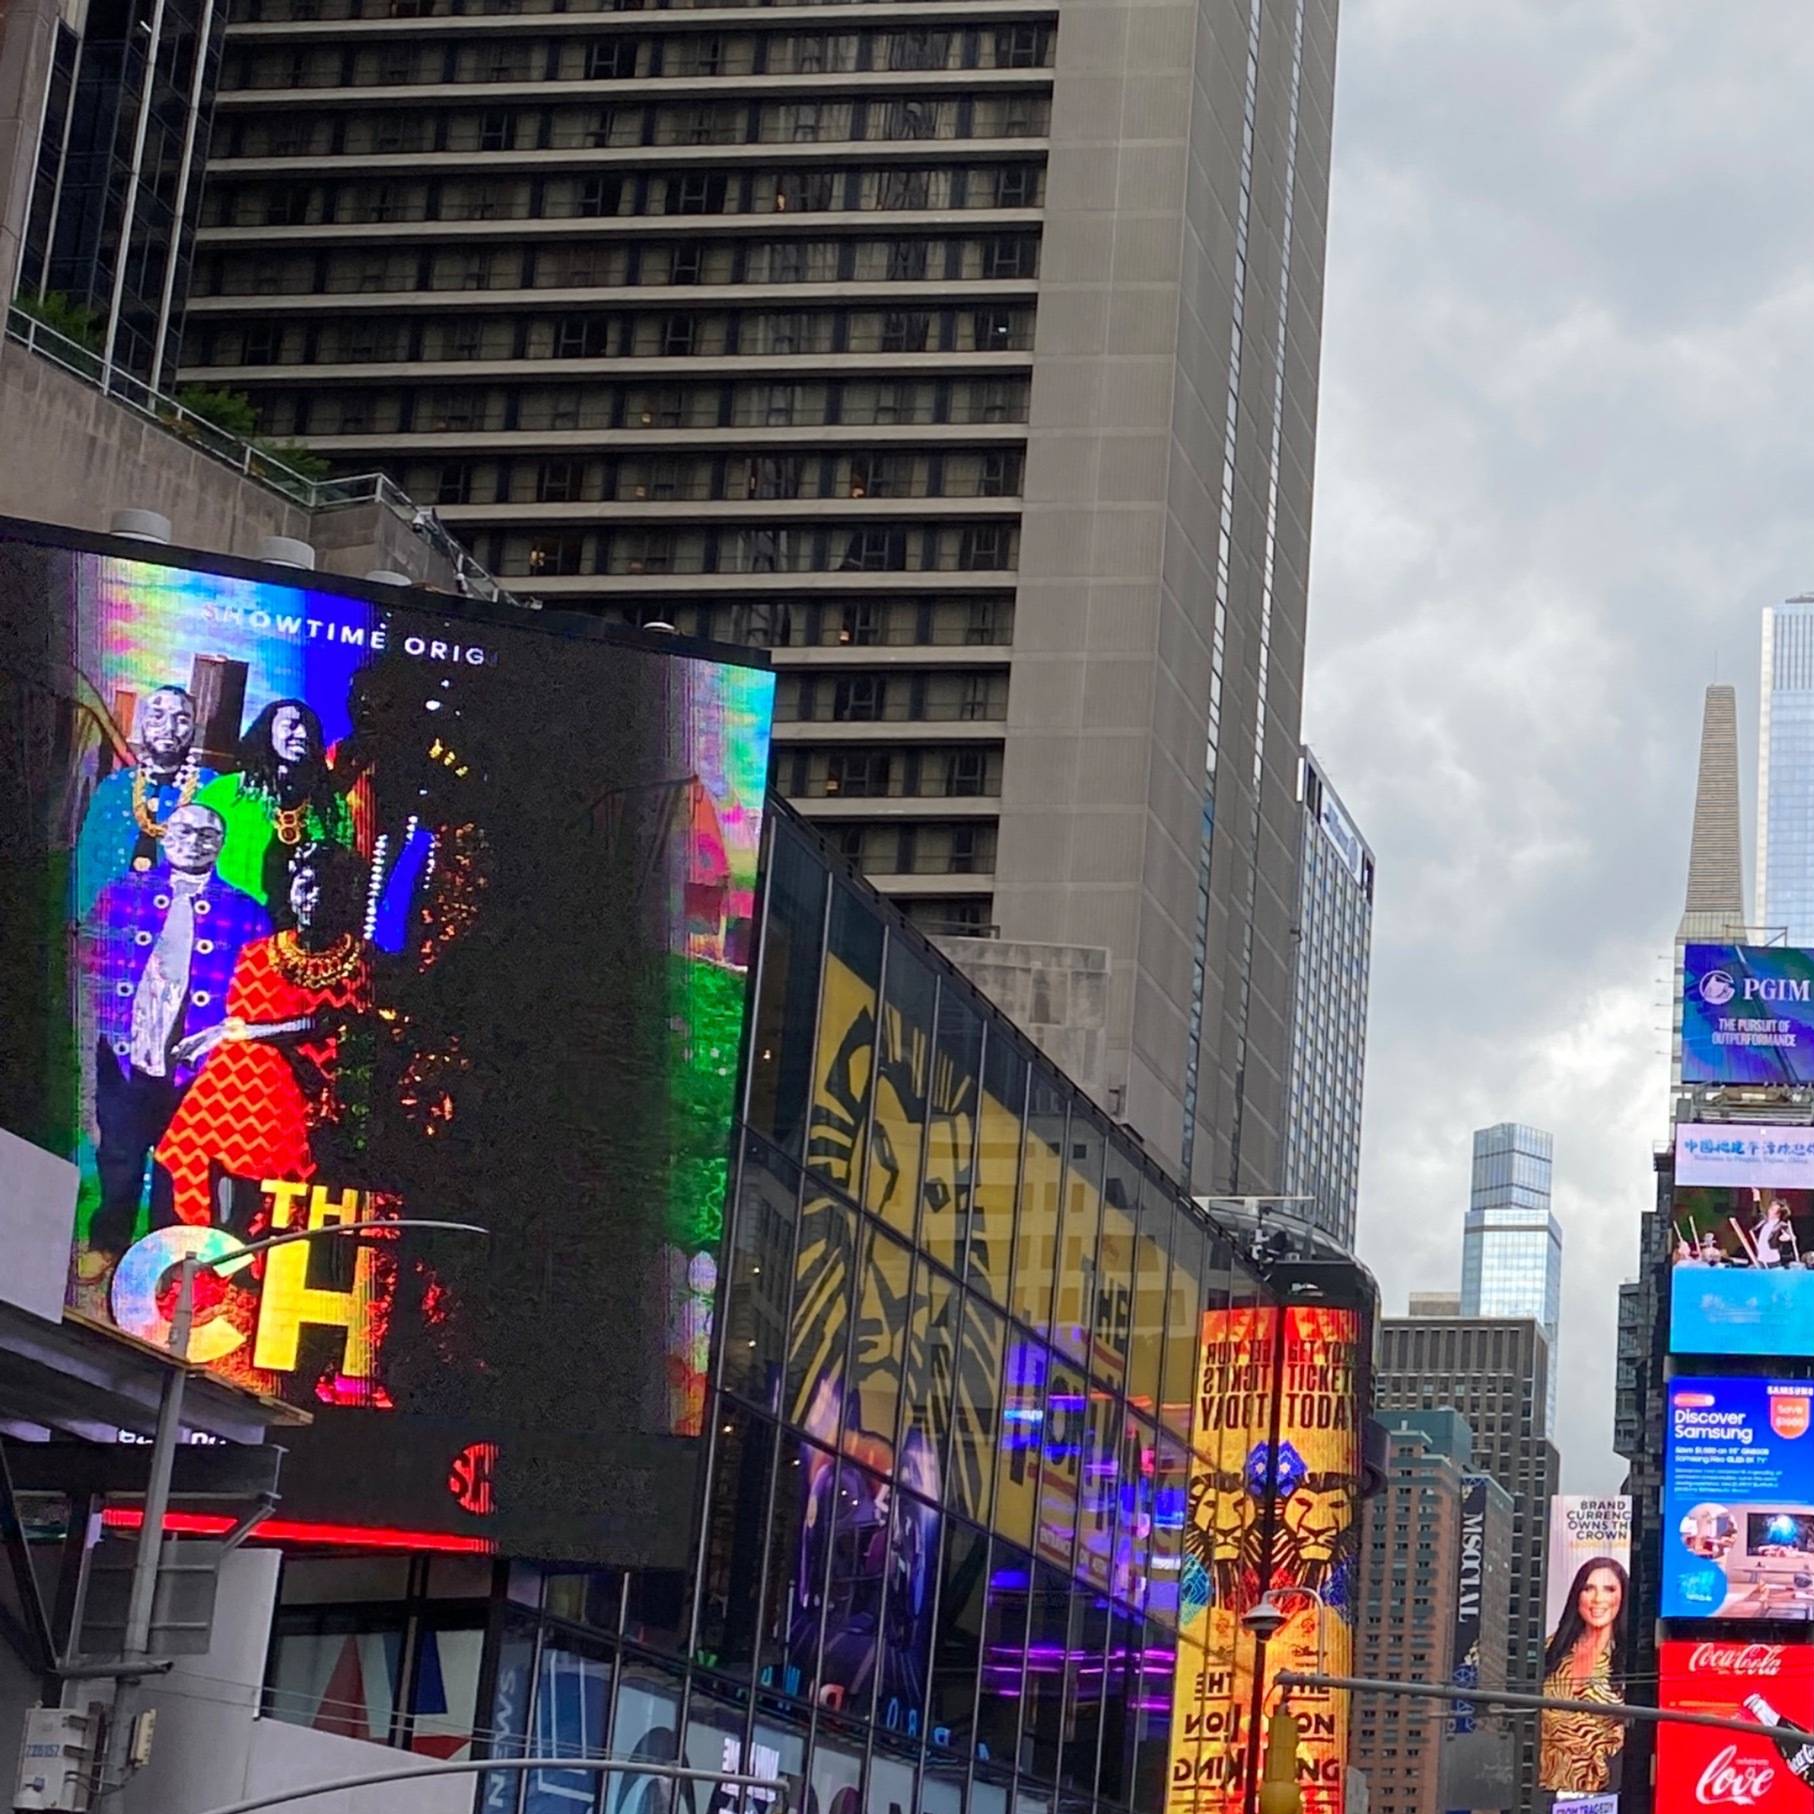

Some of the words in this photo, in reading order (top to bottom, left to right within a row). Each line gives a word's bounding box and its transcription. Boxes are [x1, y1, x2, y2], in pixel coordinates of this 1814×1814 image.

[202, 602, 388, 650] SHOWTIME
[1743, 978, 1810, 1002] PGIM
[1718, 1018, 1736, 1032] THE
[1738, 1018, 1777, 1032] PURSUIT
[1778, 1019, 1791, 1033] OF
[1711, 1033, 1797, 1047] OUTPERFORMANCE
[1287, 1363, 1353, 1394] TICKET
[1674, 1409, 1746, 1425] Discover
[1674, 1425, 1753, 1445] Samsung
[1580, 1501, 1626, 1511] BRAND
[1566, 1511, 1631, 1521] CURRENC
[1567, 1521, 1606, 1531] OWNS
[1575, 1530, 1628, 1541] CROWN
